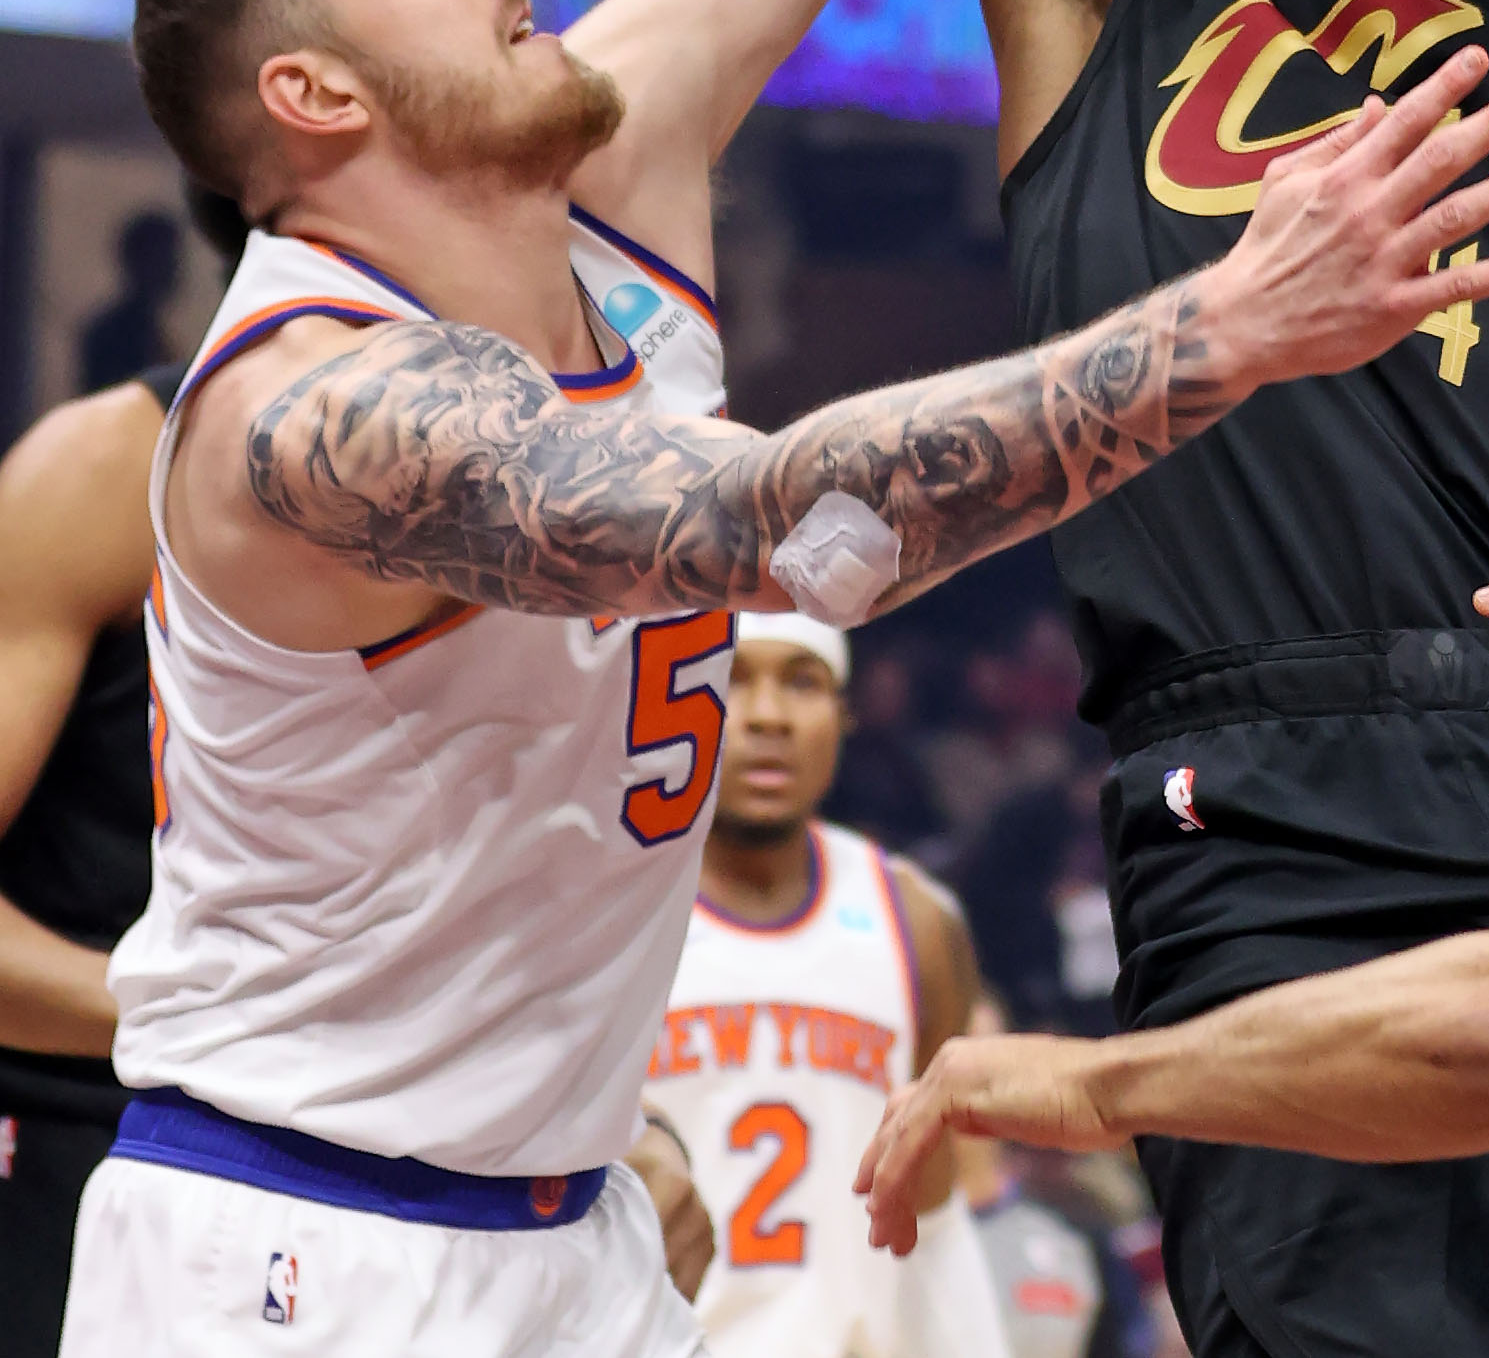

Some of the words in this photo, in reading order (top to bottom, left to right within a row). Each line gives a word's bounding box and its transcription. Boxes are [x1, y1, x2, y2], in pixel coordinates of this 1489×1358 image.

[620, 609, 735, 848] 5
[767, 1001, 897, 1092] YORK
[728, 1100, 809, 1270] 2
